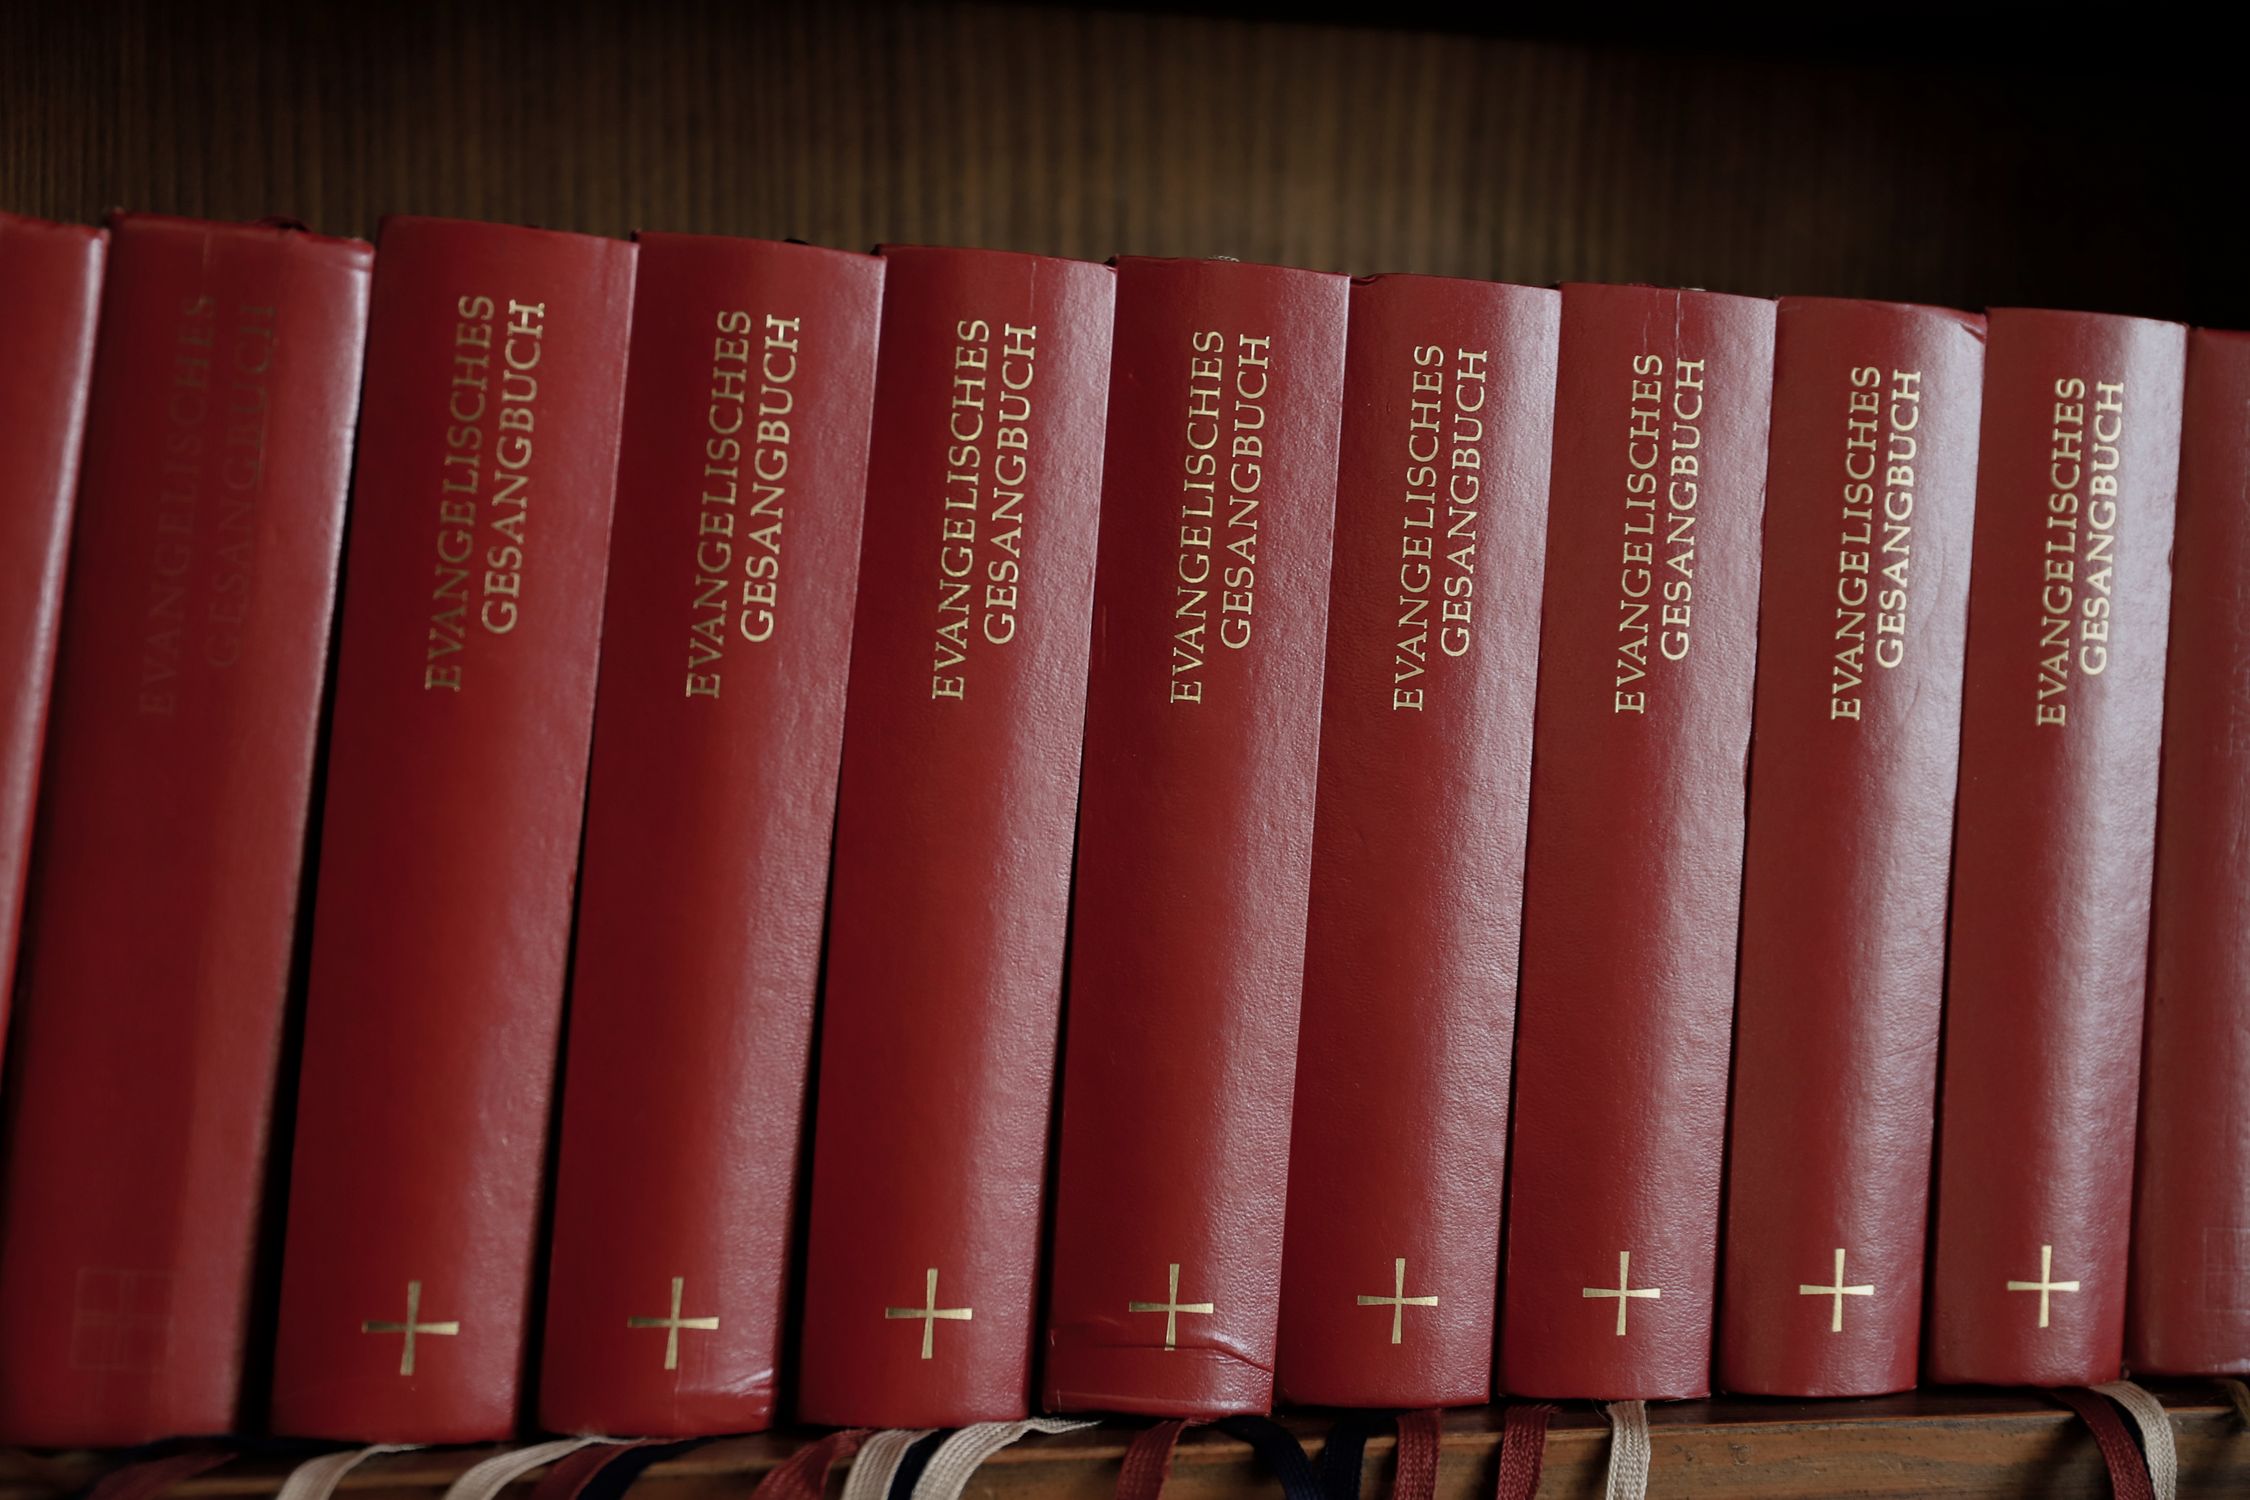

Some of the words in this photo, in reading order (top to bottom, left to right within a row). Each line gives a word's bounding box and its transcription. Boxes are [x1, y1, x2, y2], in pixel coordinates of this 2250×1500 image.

[425, 295, 495, 691] EVANGELISCHES
[482, 300, 545, 634] GESANGBUCH
[686, 310, 751, 698] EVANGELISCHES
[740, 314, 800, 643] GESANGBUCH
[932, 319, 990, 701] EVANGELISCHES
[983, 324, 1037, 644] GESANGBUCH
[1170, 330, 1224, 704] EVANGELISCHES
[1221, 335, 1270, 648] GESANGBUCH
[1393, 345, 1445, 711] EVANGELISCHES
[1441, 350, 1487, 656] GESANGBUCH
[1615, 354, 1663, 714] EVANGELISCHES
[1661, 357, 1705, 661] GESANGBUCH
[1831, 366, 1882, 720] EVANGELISCHES
[1876, 370, 1922, 669] GESANGBUCH
[2037, 377, 2085, 726] EVANGELISCHES
[2079, 381, 2124, 676] GESANGBUCH
